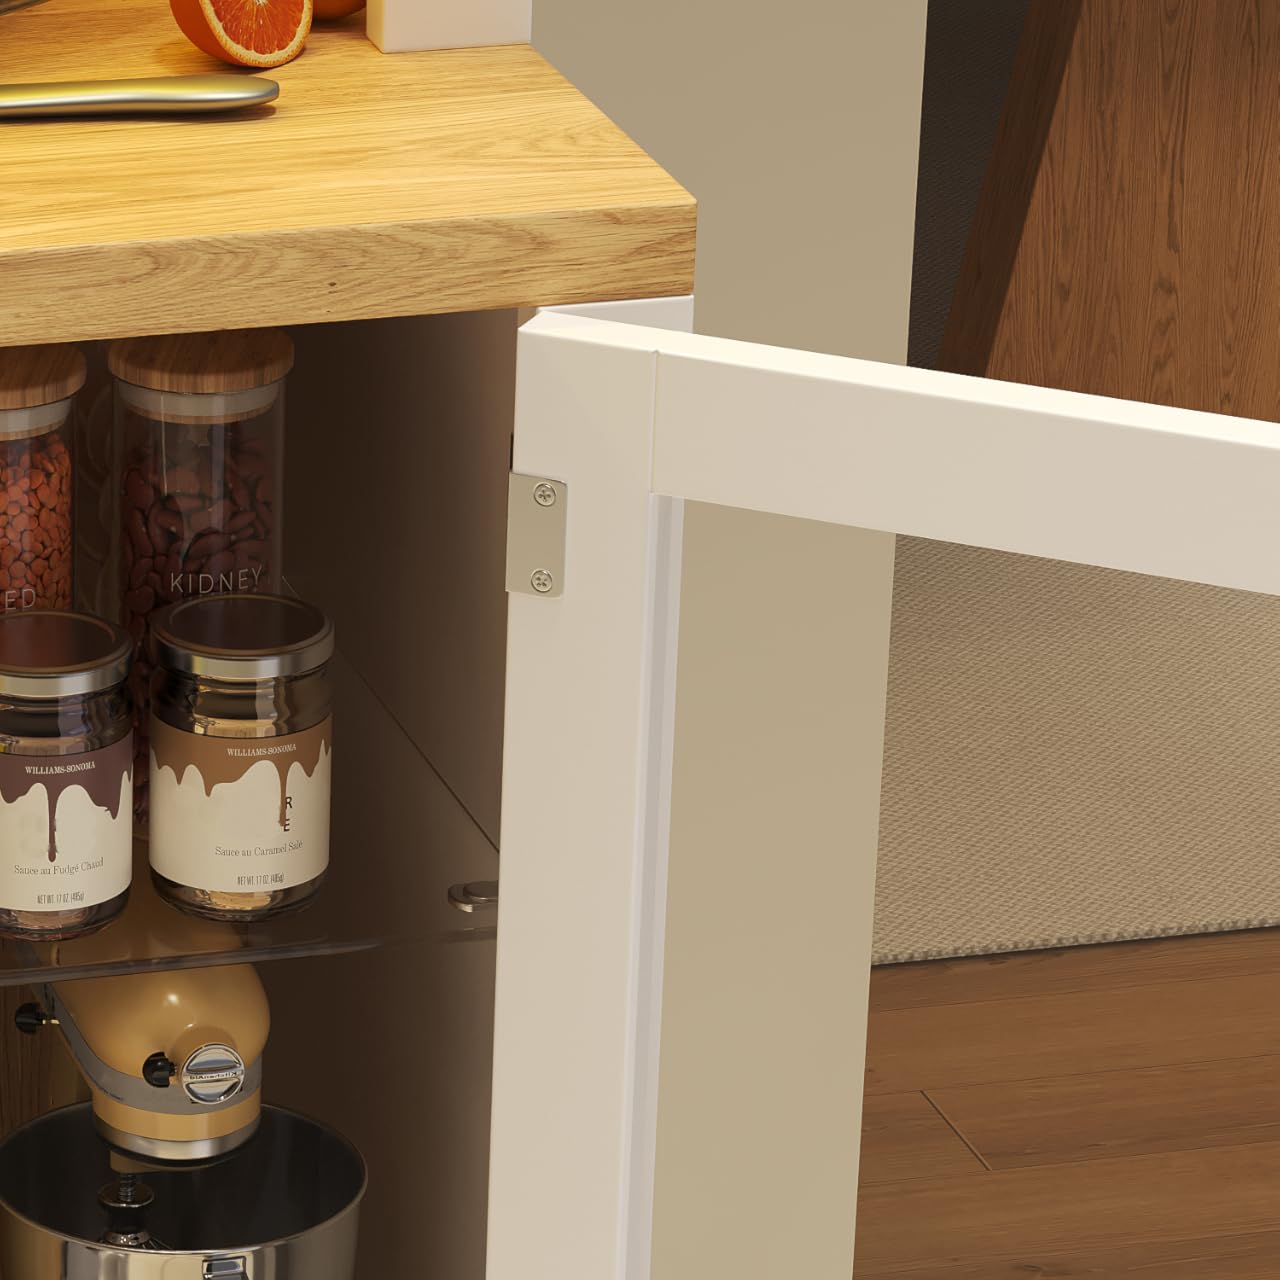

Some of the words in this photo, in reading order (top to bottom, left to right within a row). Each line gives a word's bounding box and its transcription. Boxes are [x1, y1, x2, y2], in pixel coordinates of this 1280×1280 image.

[171, 565, 262, 594] KIDNEY
[227, 743, 297, 757] WILLIAMS-SONOMA
[24, 761, 96, 775] WILLIAMS-SONOMA
[215, 846, 240, 857] Sauce
[241, 848, 252, 857] au
[254, 844, 287, 857] Caramel
[14, 864, 39, 875] Sauce
[40, 866, 51, 875] au
